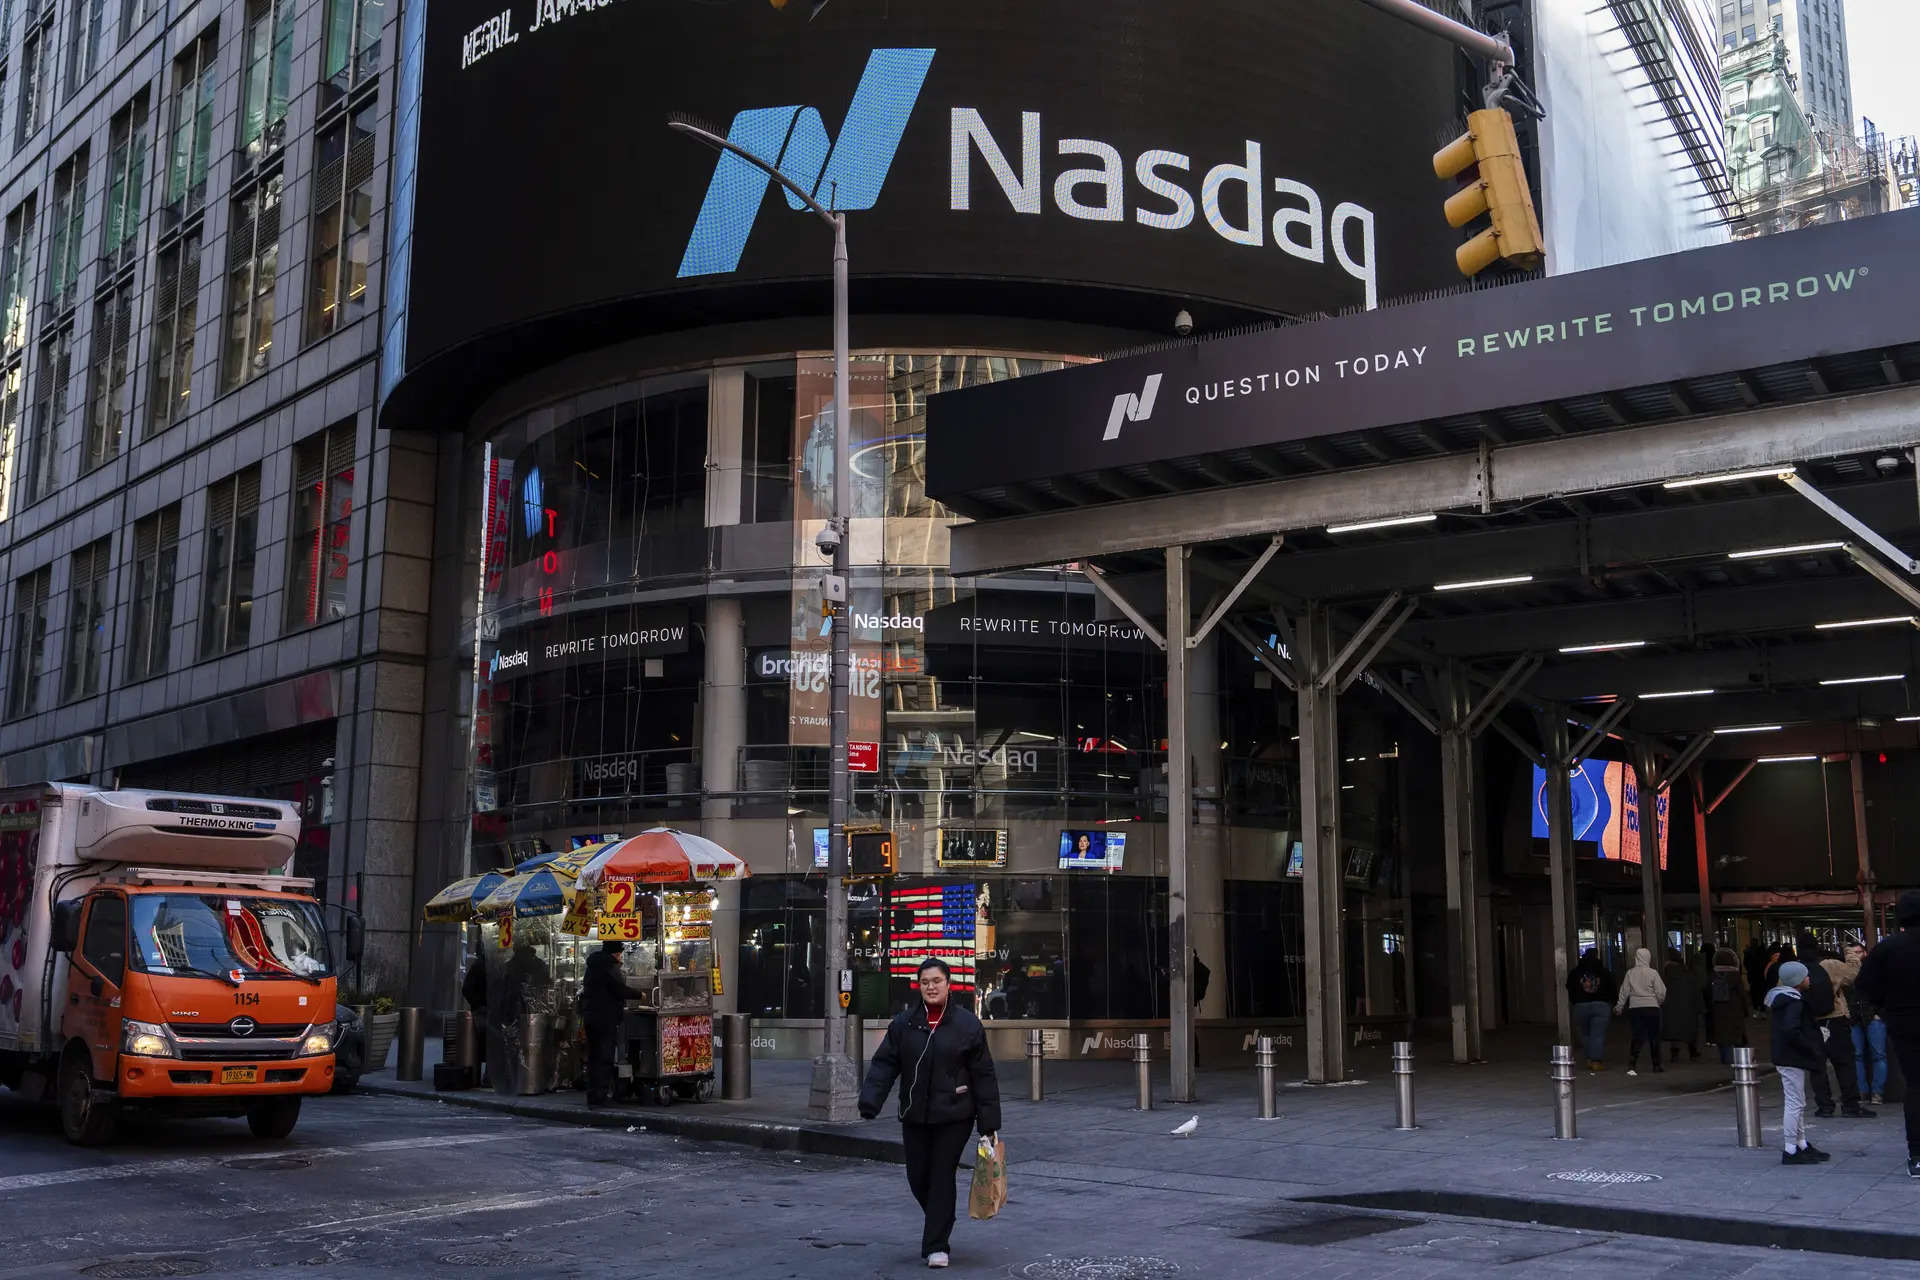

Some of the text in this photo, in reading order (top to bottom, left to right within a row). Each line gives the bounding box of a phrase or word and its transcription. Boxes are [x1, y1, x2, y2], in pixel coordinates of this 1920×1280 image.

[461, 9, 519, 69] NEGRIL,
[950, 107, 1377, 311] Nasdaq
[1185, 364, 1322, 405] QUESTION
[1335, 345, 1430, 378] TODAY
[1457, 312, 1614, 358] REWRITE
[855, 613, 924, 632] Nasdaq
[960, 617, 1146, 640] REWRITE TOMORROW
[545, 626, 684, 658] REWRITE TOMORROW
[499, 650, 528, 670] Nasdaq
[584, 757, 638, 781] Nasdaq
[943, 747, 1038, 772] Nasdaq
[179, 816, 254, 830] THERMO KING
[881, 841, 891, 868] 9
[608, 883, 631, 912] $2
[618, 919, 638, 938] $5
[854, 949, 1010, 959] REWRITE TOMOROW
[233, 992, 260, 1005] 1154
[1104, 1036, 1135, 1049] Nasd
